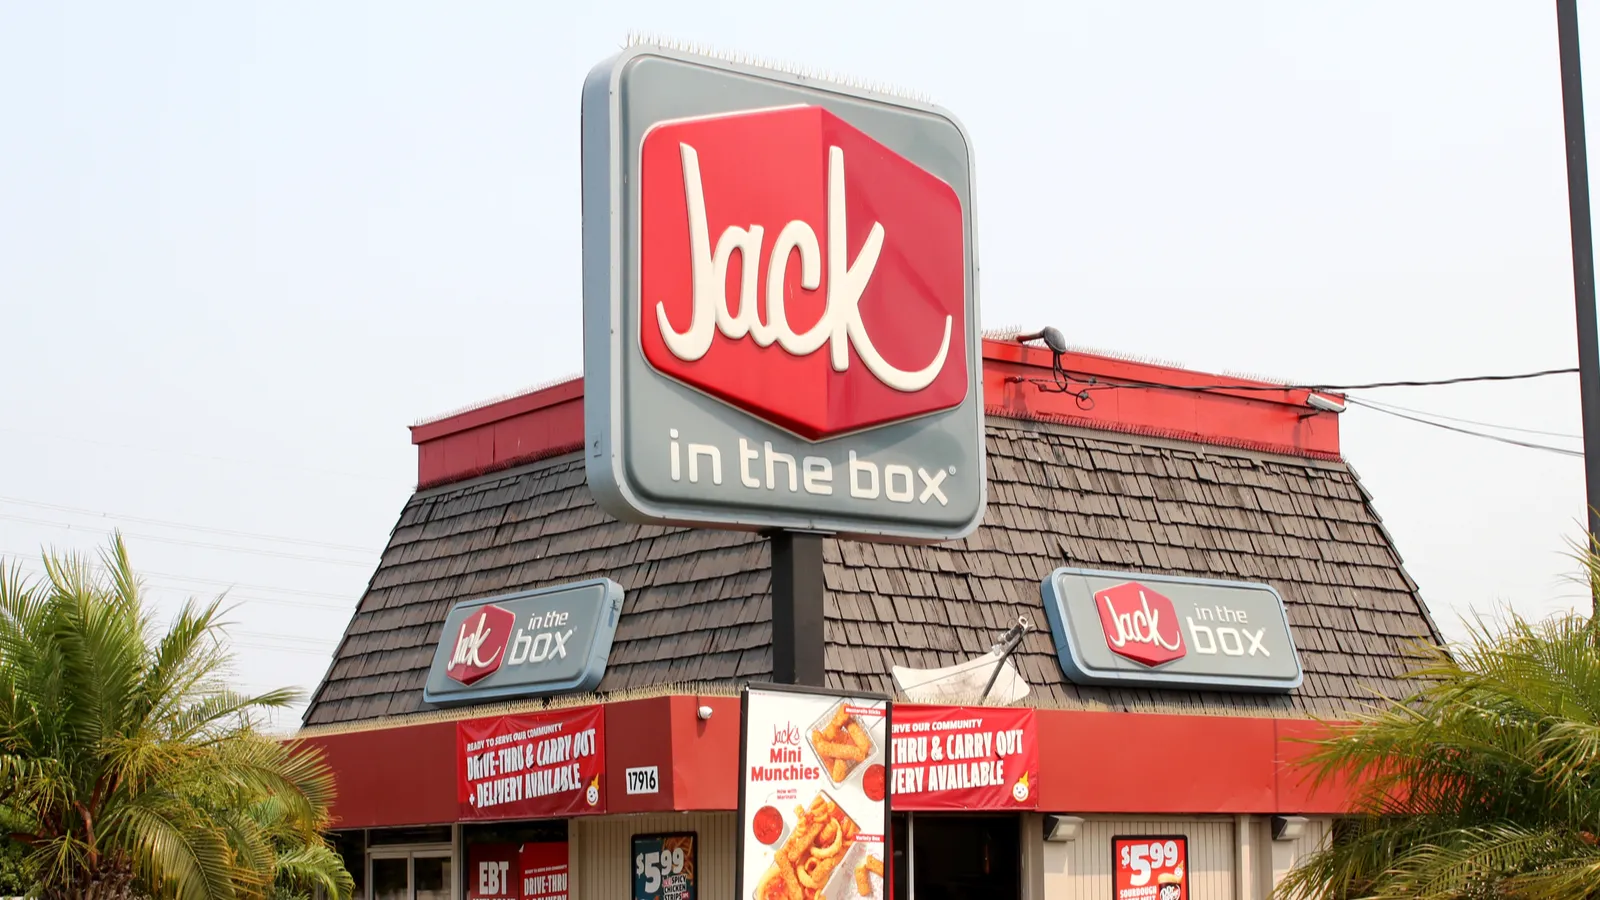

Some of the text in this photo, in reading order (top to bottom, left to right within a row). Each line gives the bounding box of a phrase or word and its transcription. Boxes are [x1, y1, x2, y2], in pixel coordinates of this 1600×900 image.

[656, 142, 952, 392] Jack
[670, 428, 949, 507] in the box
[528, 610, 569, 631] in the
[1104, 590, 1180, 651] Jack
[1193, 602, 1248, 624] in the
[447, 612, 502, 671] Jack
[508, 628, 573, 666] box
[1186, 616, 1270, 657] box
[467, 722, 563, 752] READY TO SERVE OUR COMMUNITY
[772, 720, 800, 746] Jack's
[912, 722, 930, 732] OUR
[932, 718, 983, 732] COMMUNITY
[467, 728, 596, 781] DRIVE-THRU & CARRY OUT
[770, 747, 801, 763] Mini
[930, 735, 944, 762] &
[946, 732, 993, 760] CARRY
[996, 729, 1024, 758] OUT
[477, 775, 523, 808] DELIVERY
[525, 763, 581, 799] AVAILABLE
[628, 770, 657, 791] 17916
[751, 764, 820, 782] Munchies
[928, 760, 1005, 792] AVAILABLE
[479, 861, 509, 895] EBT
[524, 872, 567, 896] DRIVE-THRU
[665, 884, 686, 893] CHICKEN
[671, 875, 686, 884] SPICY
[1120, 885, 1157, 898] SOURDOUGH
